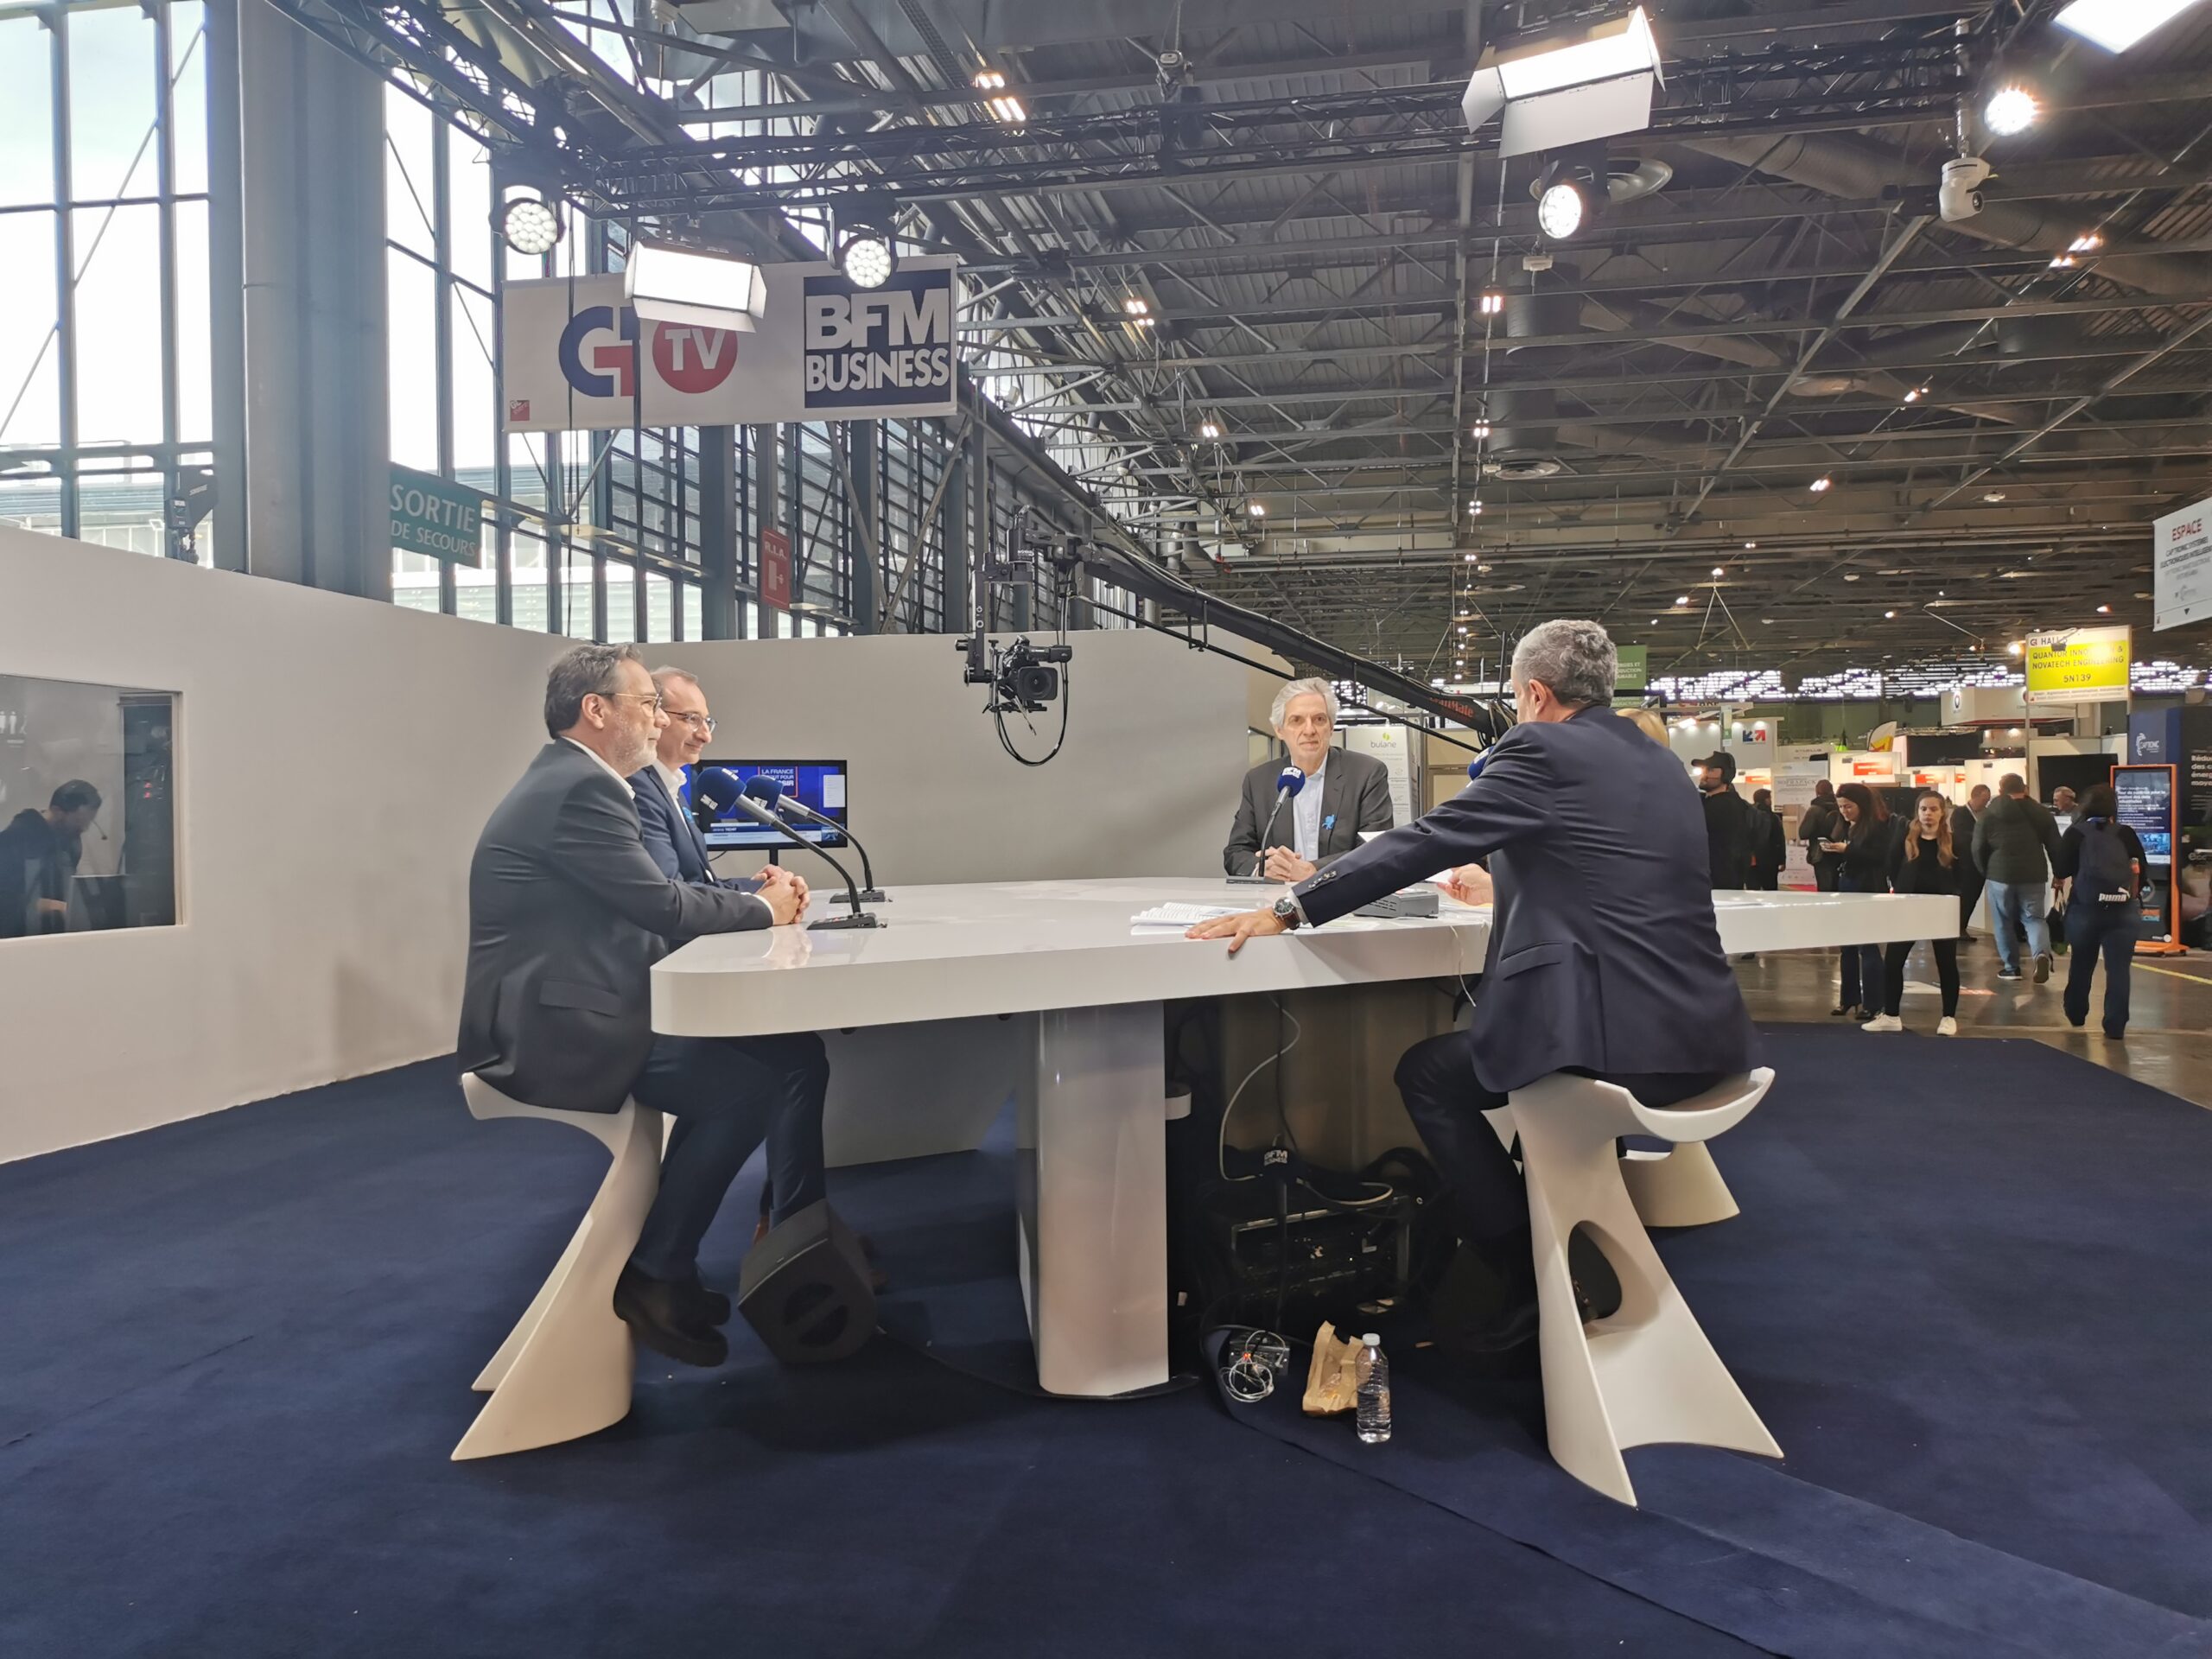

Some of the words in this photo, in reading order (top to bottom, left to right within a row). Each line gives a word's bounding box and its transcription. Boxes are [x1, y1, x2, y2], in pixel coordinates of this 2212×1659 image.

[806, 288, 950, 350] BFM
[664, 327, 727, 372] TV
[806, 348, 950, 391] BUSINESS
[390, 484, 475, 533] SORTIE
[391, 519, 410, 541] DE
[416, 526, 475, 558] SECOURS
[2171, 518, 2202, 542] ESPACE
[2032, 660, 2070, 670] NOVATECH
[2033, 650, 2067, 659] QUANTOR
[2063, 674, 2091, 683] 5N139
